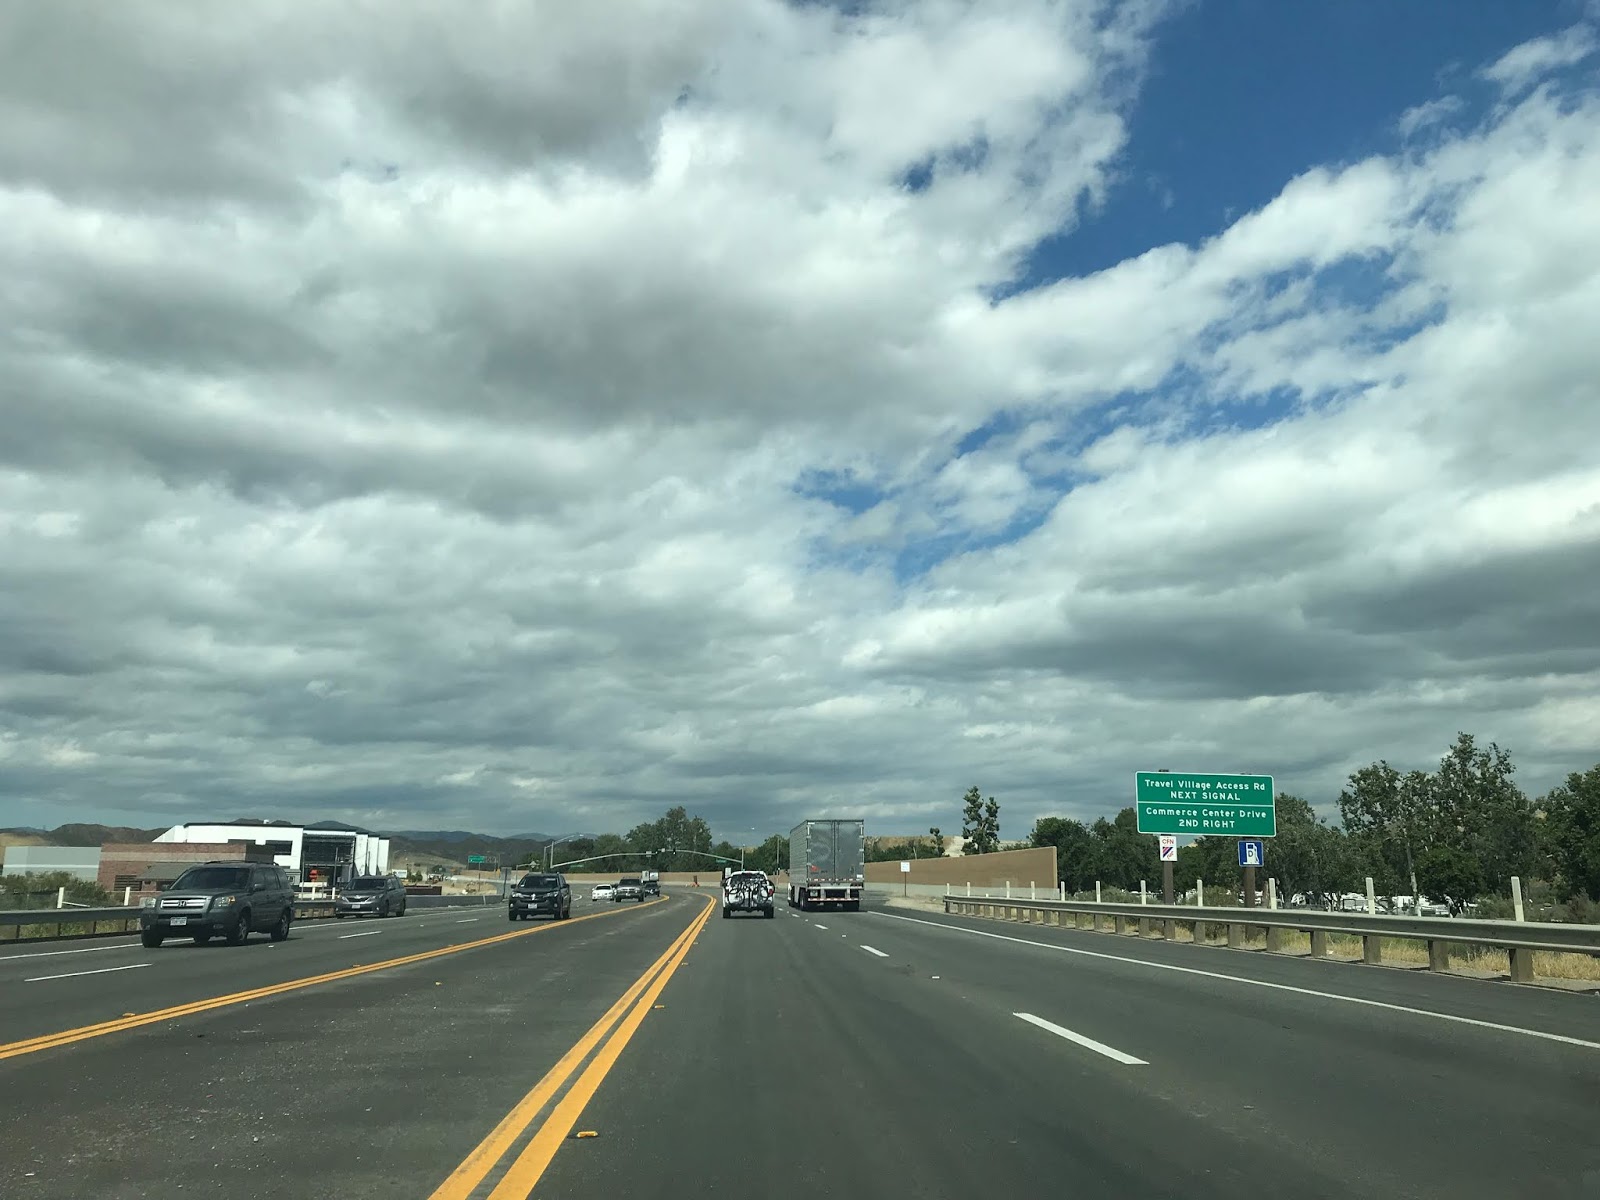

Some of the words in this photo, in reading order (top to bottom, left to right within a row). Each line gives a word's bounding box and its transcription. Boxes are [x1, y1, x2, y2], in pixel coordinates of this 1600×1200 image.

[1145, 779, 1173, 788] Travel
[1178, 780, 1211, 790] Village
[1216, 781, 1249, 790] Access
[1253, 782, 1265, 790] Rd
[1170, 791, 1197, 799] NEXT
[1202, 792, 1241, 801] SIGNAL
[1146, 807, 1198, 816] Commerce
[1202, 808, 1235, 817] Center
[1239, 810, 1267, 818] Drive
[1178, 819, 1199, 827] 2ND
[1203, 820, 1235, 828] RIGHT
